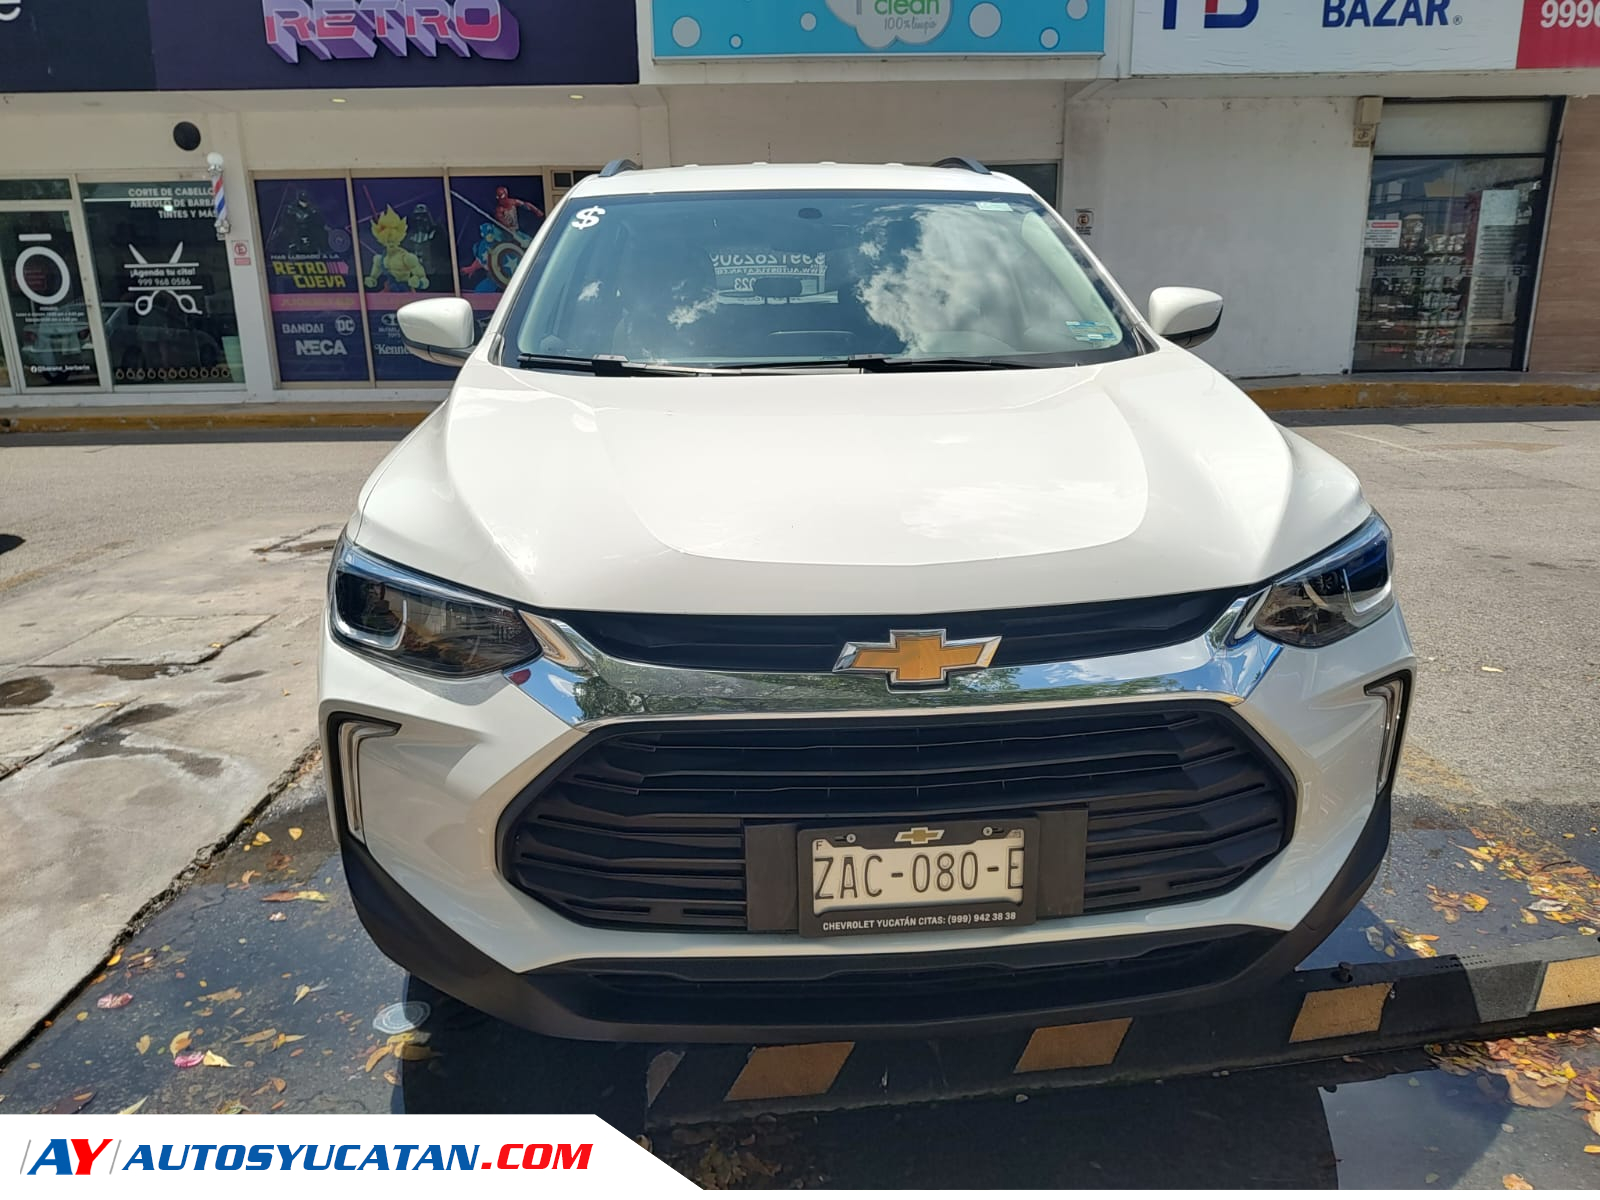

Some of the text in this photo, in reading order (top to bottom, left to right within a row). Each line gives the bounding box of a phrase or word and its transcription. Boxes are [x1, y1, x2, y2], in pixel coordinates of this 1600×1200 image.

[263, 0, 508, 53] RETRO
[128, 187, 159, 197] CORTE
[161, 187, 173, 196] DE
[130, 199, 173, 208] ARREGLO
[174, 199, 186, 207] DE
[158, 209, 188, 219] TINTES
[190, 209, 198, 218] Y
[130, 267, 196, 278] ¡Agenda tu cita!
[272, 261, 328, 275] RETRO
[293, 275, 346, 288] CUEVA
[282, 323, 324, 334] BANDAI
[335, 317, 355, 334] DC
[295, 339, 348, 355] NECA
[814, 847, 1024, 901] ZAC-080-E
[823, 911, 1017, 931] CHEVROLET YUCATÁN CITAS: (999) 942 38 38
